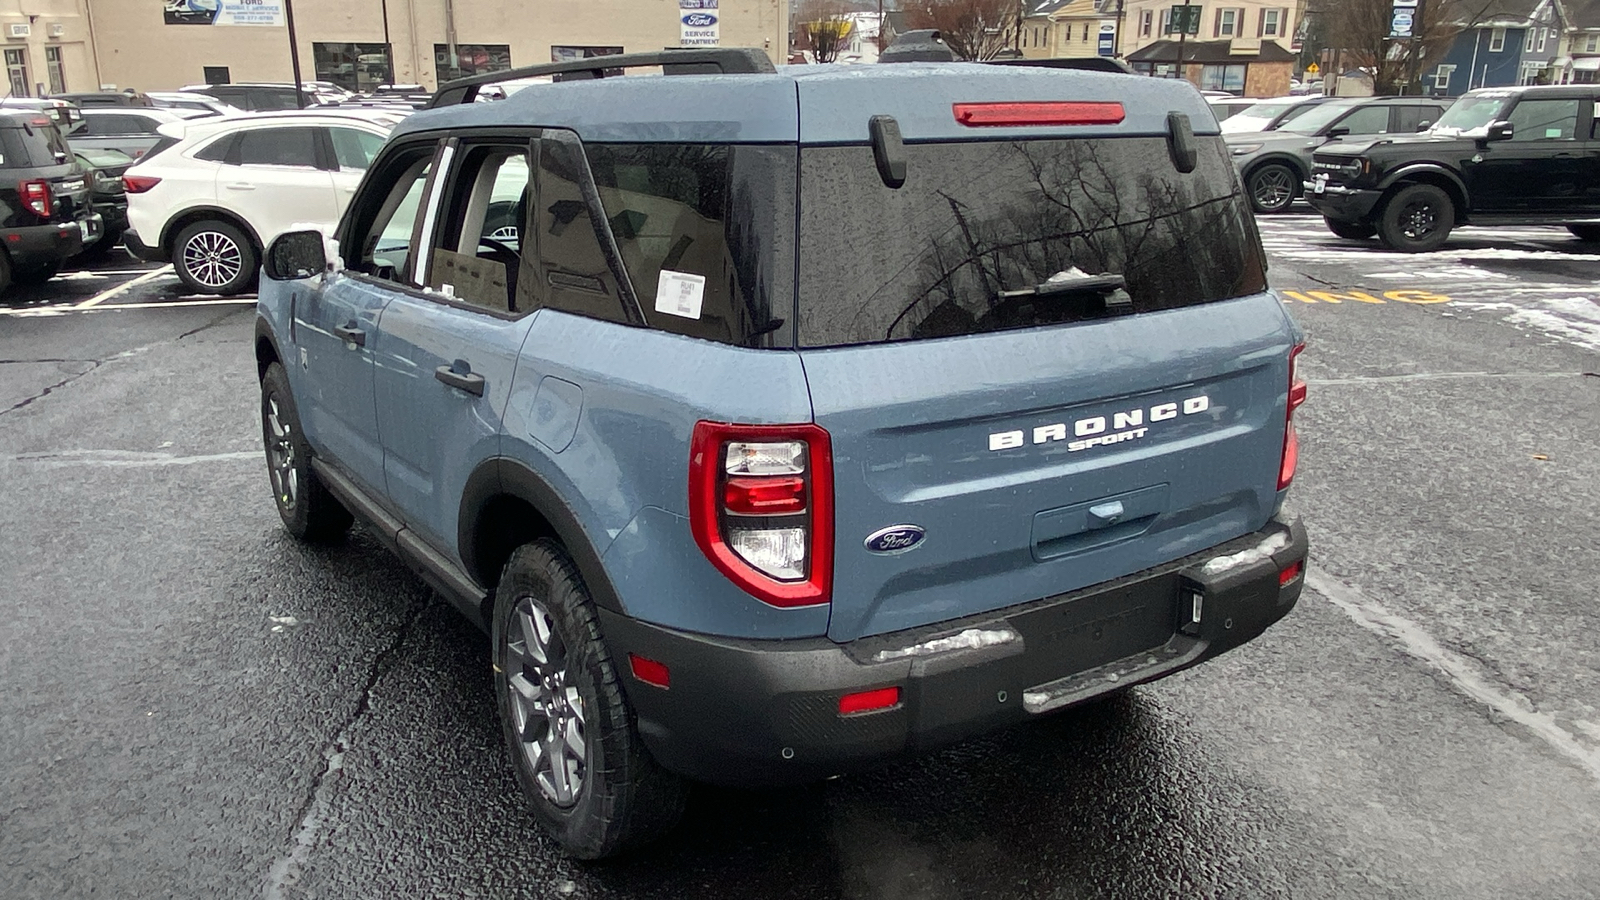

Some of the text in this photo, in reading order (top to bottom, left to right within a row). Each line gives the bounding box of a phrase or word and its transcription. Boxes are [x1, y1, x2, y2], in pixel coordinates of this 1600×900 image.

[688, 14, 712, 25] Ford
[988, 395, 1210, 451] BRONCO
[1066, 427, 1149, 452] SPORT
